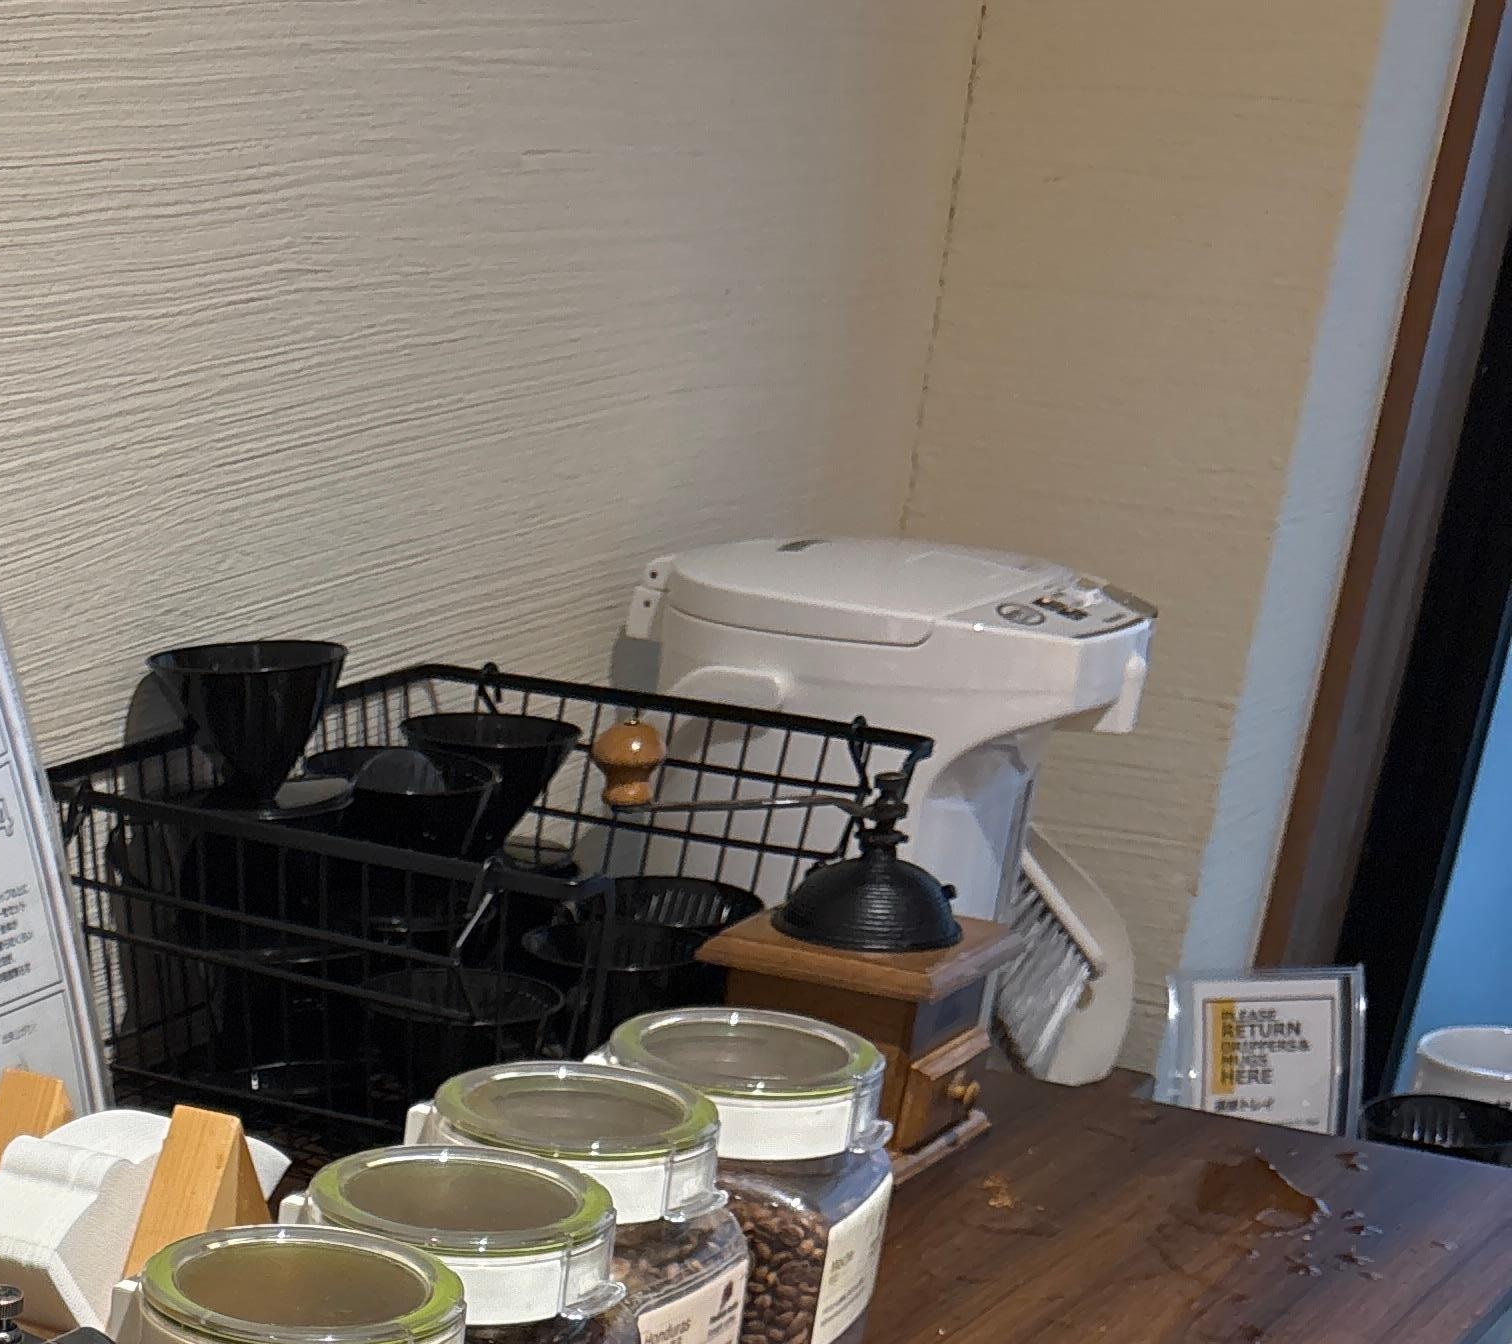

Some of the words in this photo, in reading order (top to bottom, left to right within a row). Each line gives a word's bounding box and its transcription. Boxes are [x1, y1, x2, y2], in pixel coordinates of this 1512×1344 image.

[1221, 1008, 1278, 1021] PLEASE
[1221, 1021, 1303, 1039] RETURN
[1220, 1068, 1273, 1085] HERE
